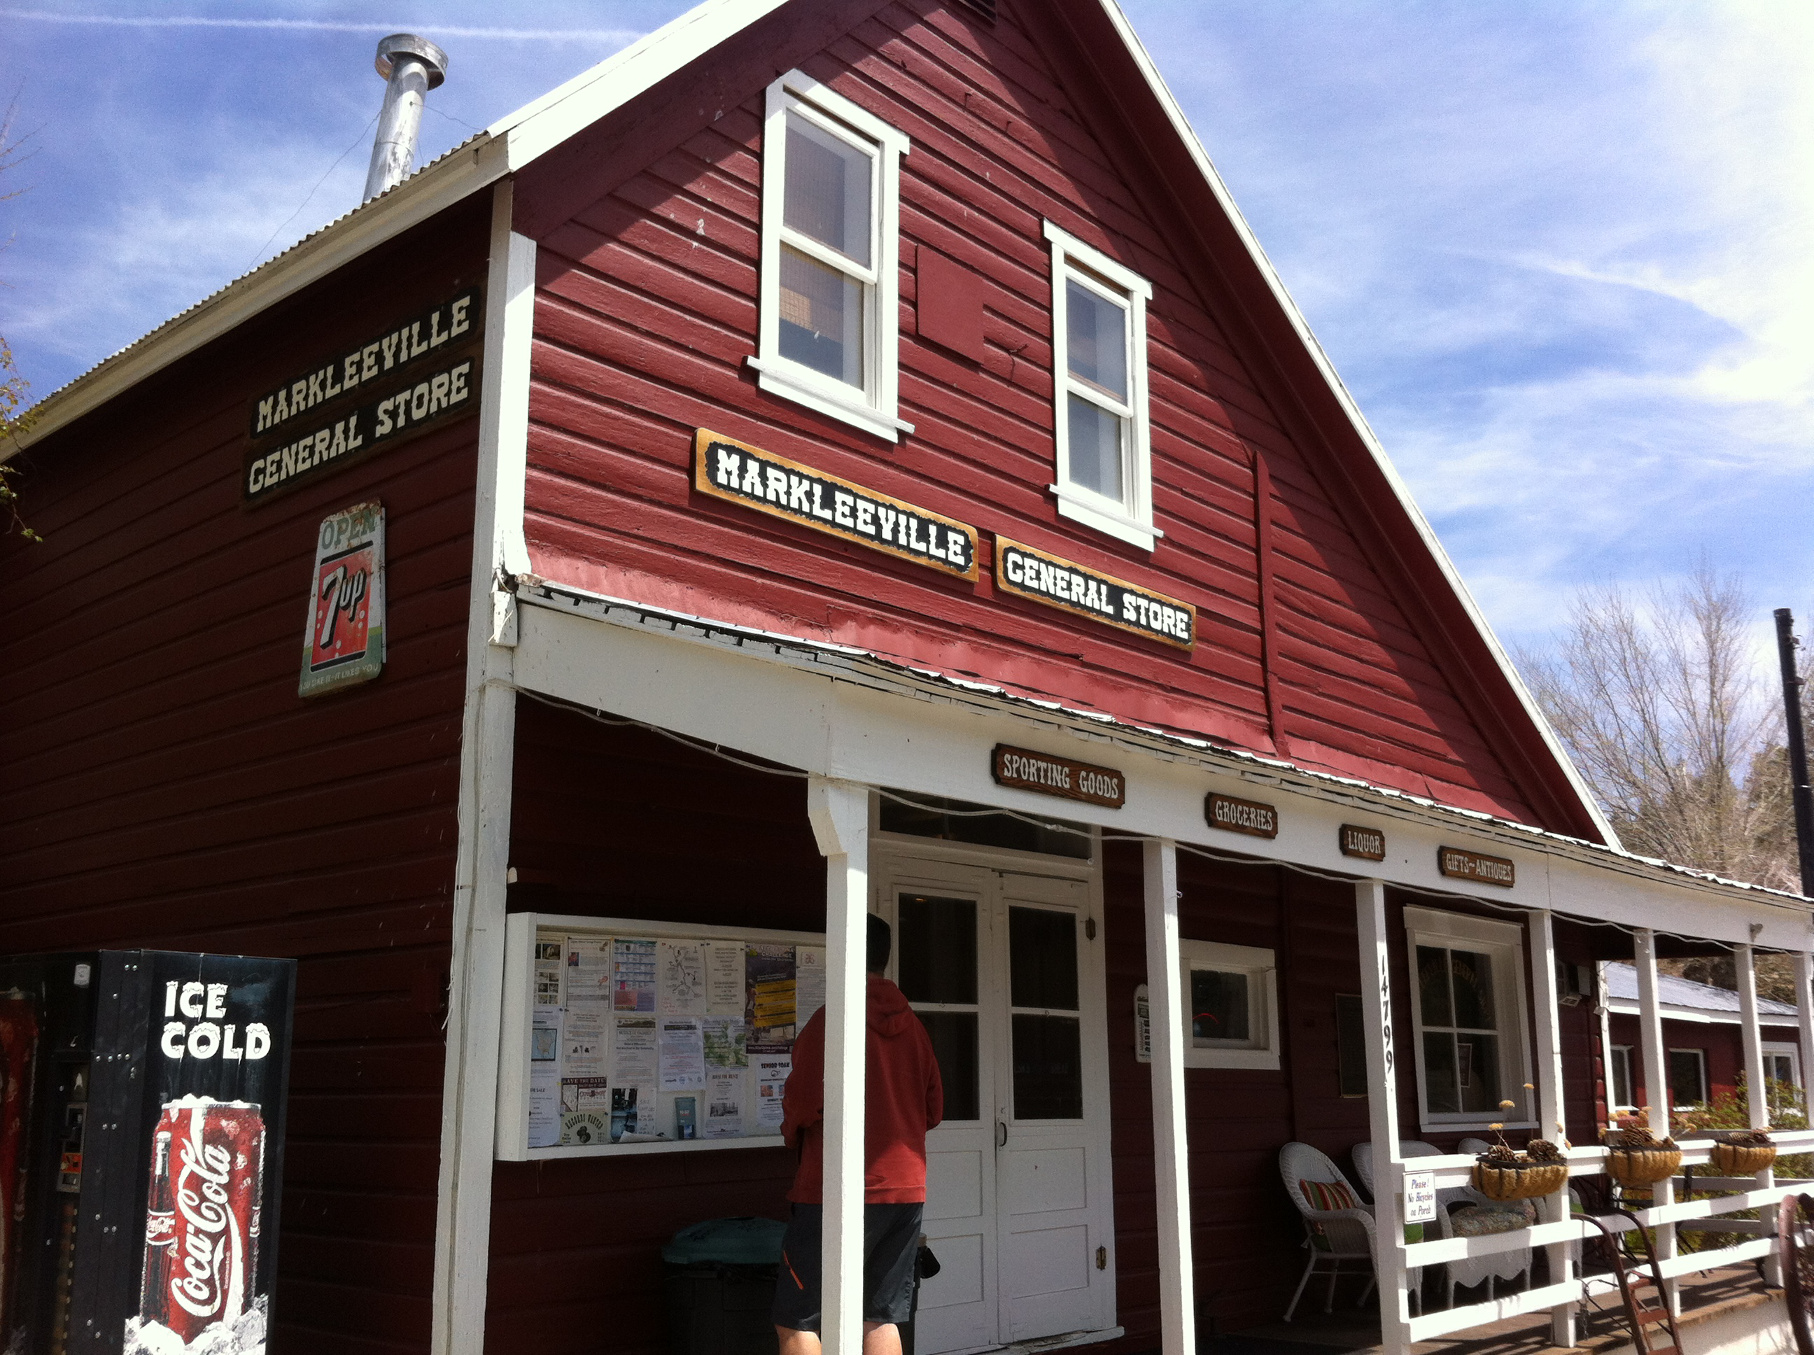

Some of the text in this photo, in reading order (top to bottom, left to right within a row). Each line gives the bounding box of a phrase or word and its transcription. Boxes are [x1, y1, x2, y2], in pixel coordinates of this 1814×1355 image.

[257, 295, 471, 433] MARKLEEVILLE
[249, 362, 471, 494] GENERAL STORE
[321, 506, 377, 550] OPEN
[716, 448, 966, 566] MARKLEEVILLE
[1007, 552, 1190, 640] GENERAL STORE
[1003, 753, 1119, 800] SPORTING GOODS
[1215, 800, 1274, 831] GROCERIES
[1347, 830, 1381, 855] LIQUOR
[164, 980, 229, 1020] ICE
[1381, 954, 1393, 1074] 14799
[161, 1021, 271, 1063] COLD
[171, 1137, 232, 1318] Coca-Cola
